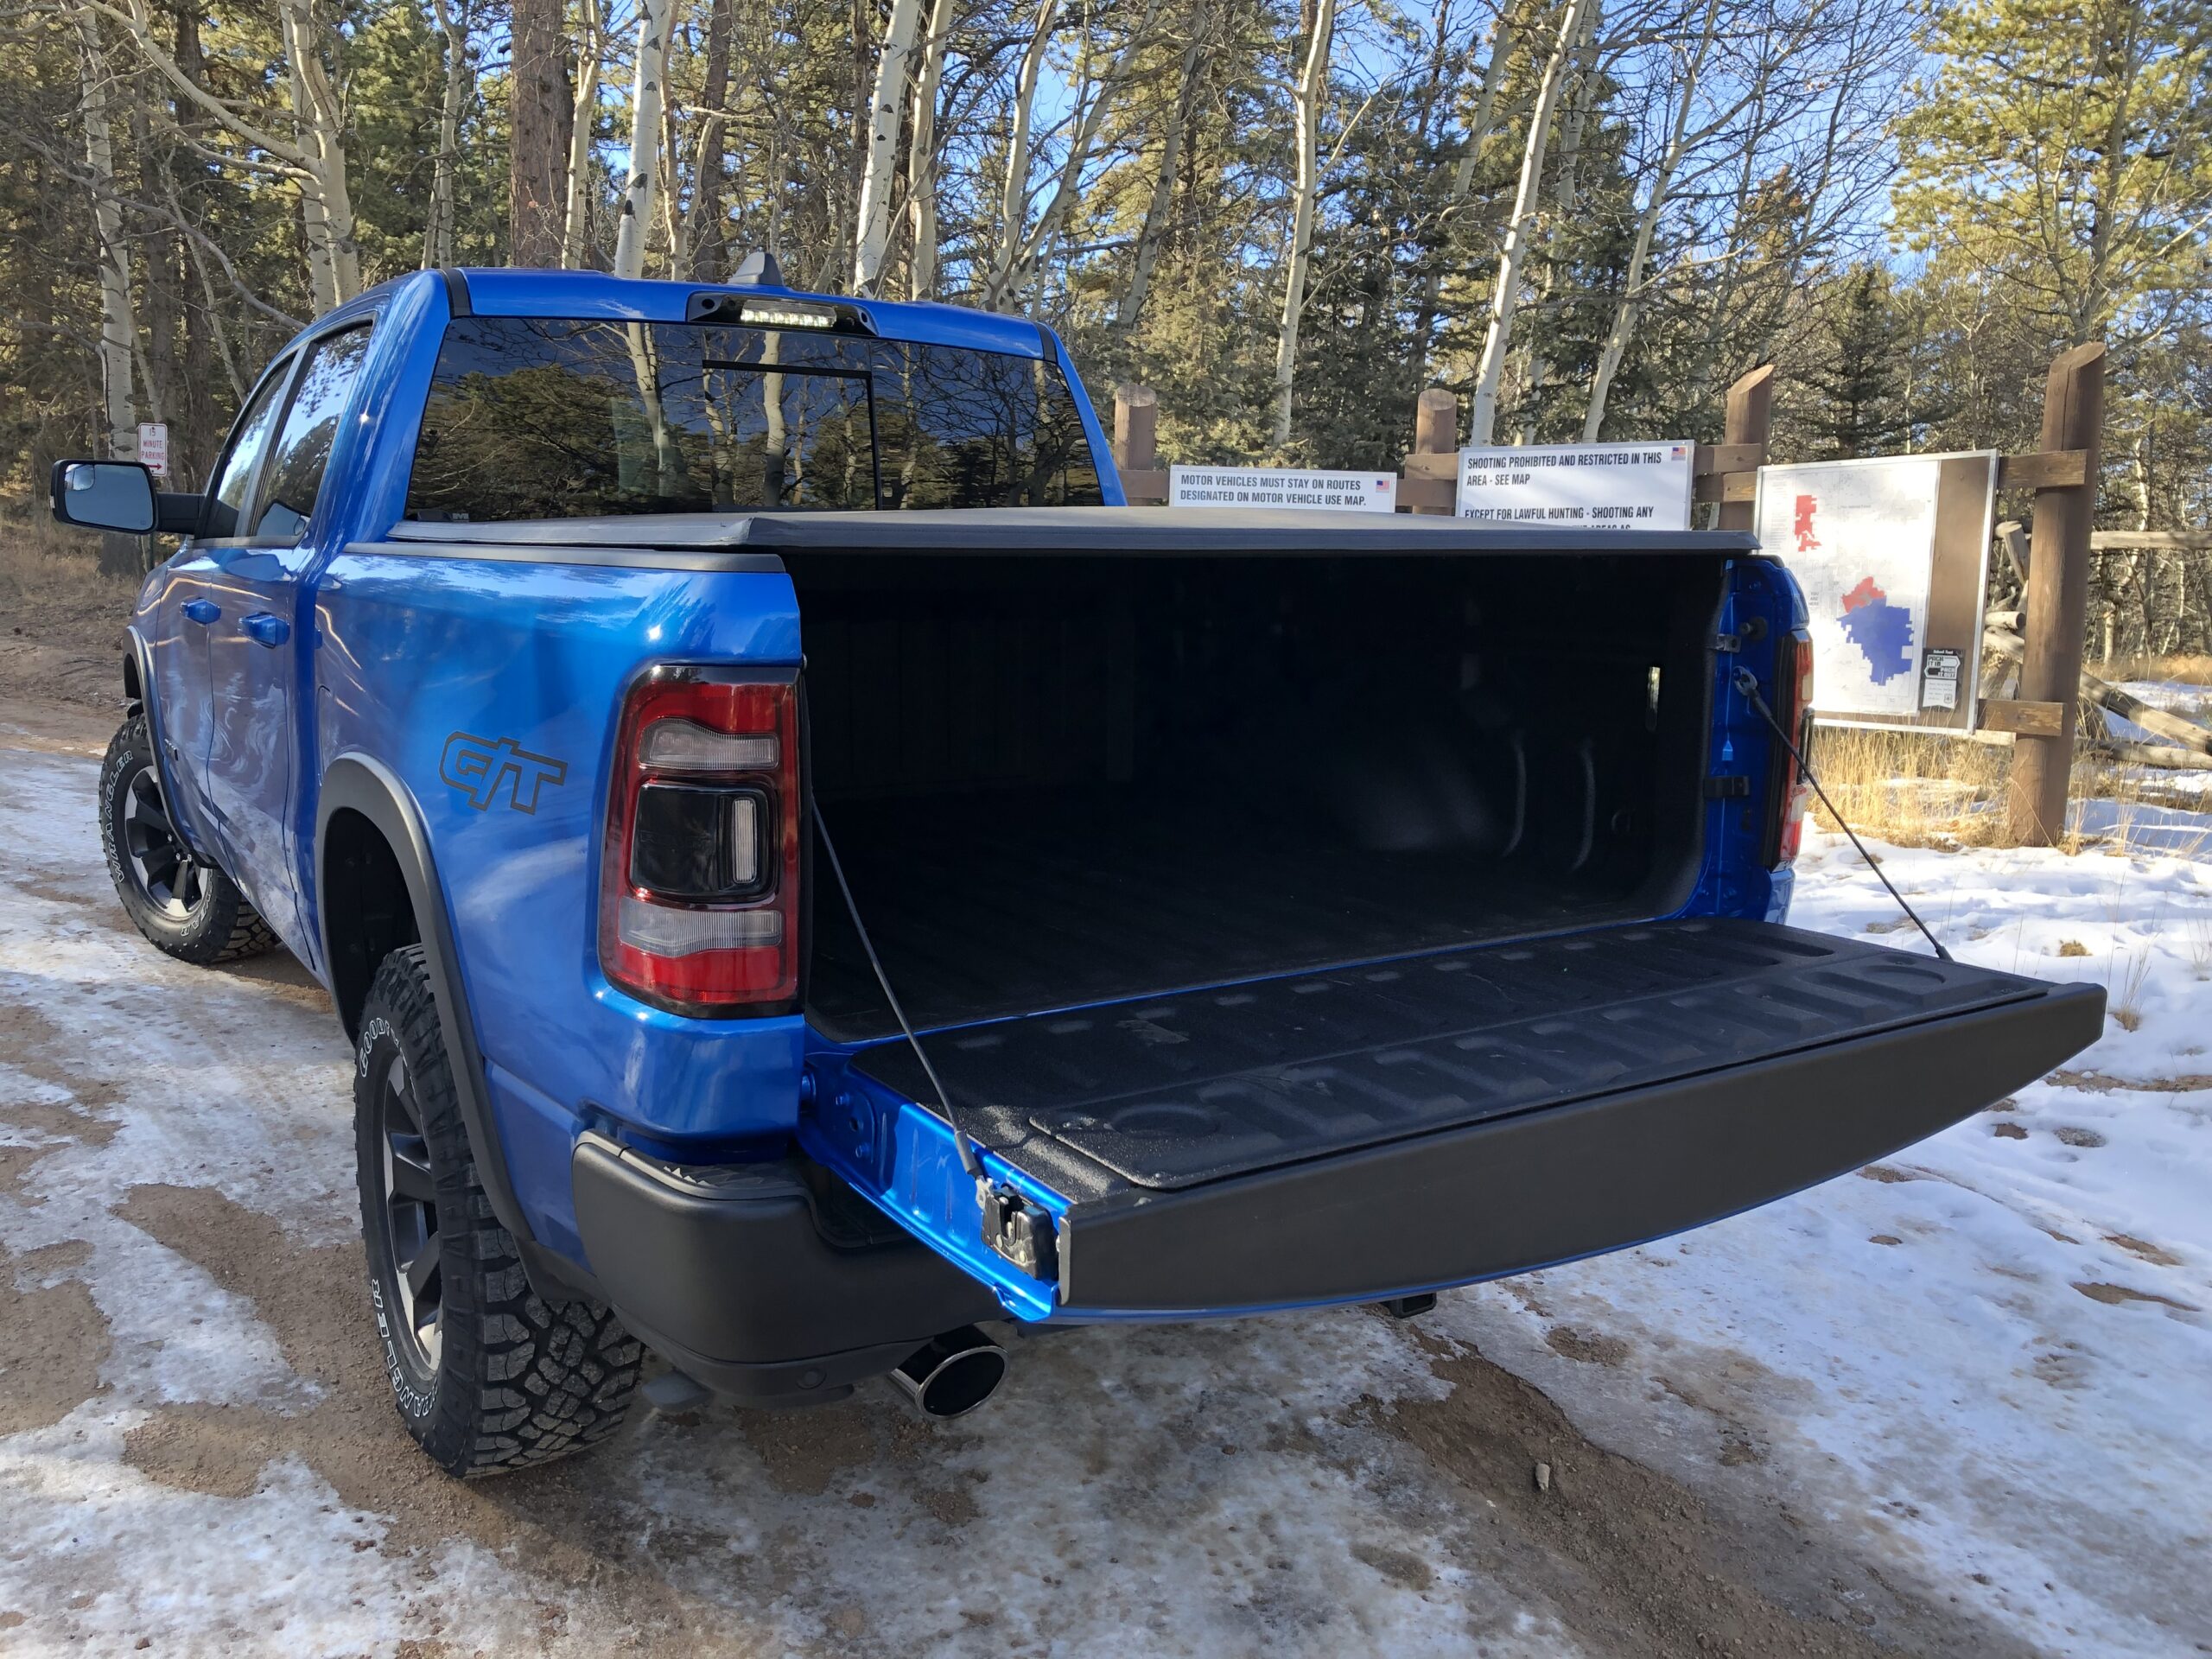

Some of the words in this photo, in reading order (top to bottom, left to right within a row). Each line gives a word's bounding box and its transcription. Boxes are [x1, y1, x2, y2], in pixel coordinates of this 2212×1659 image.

[149, 428, 156, 436] 15
[143, 440, 162, 448] MINUTE
[141, 451, 165, 461] PARKING
[1467, 456, 1507, 469] SHOOTING
[1509, 455, 1557, 467] PROHIBITED
[1559, 454, 1575, 467] AND
[1578, 453, 1629, 466] RESTRICTED
[1631, 453, 1640, 464] IN
[1643, 452, 1662, 464] THIS
[1181, 474, 1213, 486] MOTOR
[1216, 475, 1258, 487] VEHICLES
[1260, 477, 1286, 488] MUST
[1287, 478, 1309, 489] STAY
[1312, 479, 1324, 489] ON
[1326, 480, 1361, 491] ROUTES
[1466, 474, 1487, 486] AREA
[1495, 474, 1510, 486] SEE
[1511, 474, 1530, 485] MAP
[1180, 490, 1234, 501] DESIGNATED
[1236, 492, 1249, 502] ON
[1251, 492, 1283, 503] MOTOR
[1287, 493, 1322, 505] VEHICLE
[1325, 494, 1342, 505] USE
[1344, 495, 1366, 505] MAP.
[1465, 508, 1494, 519] EXCEPT
[1497, 508, 1512, 519] FOR
[1514, 507, 1546, 519] LAWFUL
[1548, 506, 1584, 518] HUNTING
[1592, 506, 1634, 518] SHOOTING
[1636, 506, 1654, 518] ANY
[439, 730, 568, 816] GT
[104, 750, 134, 883] WRANGLER
